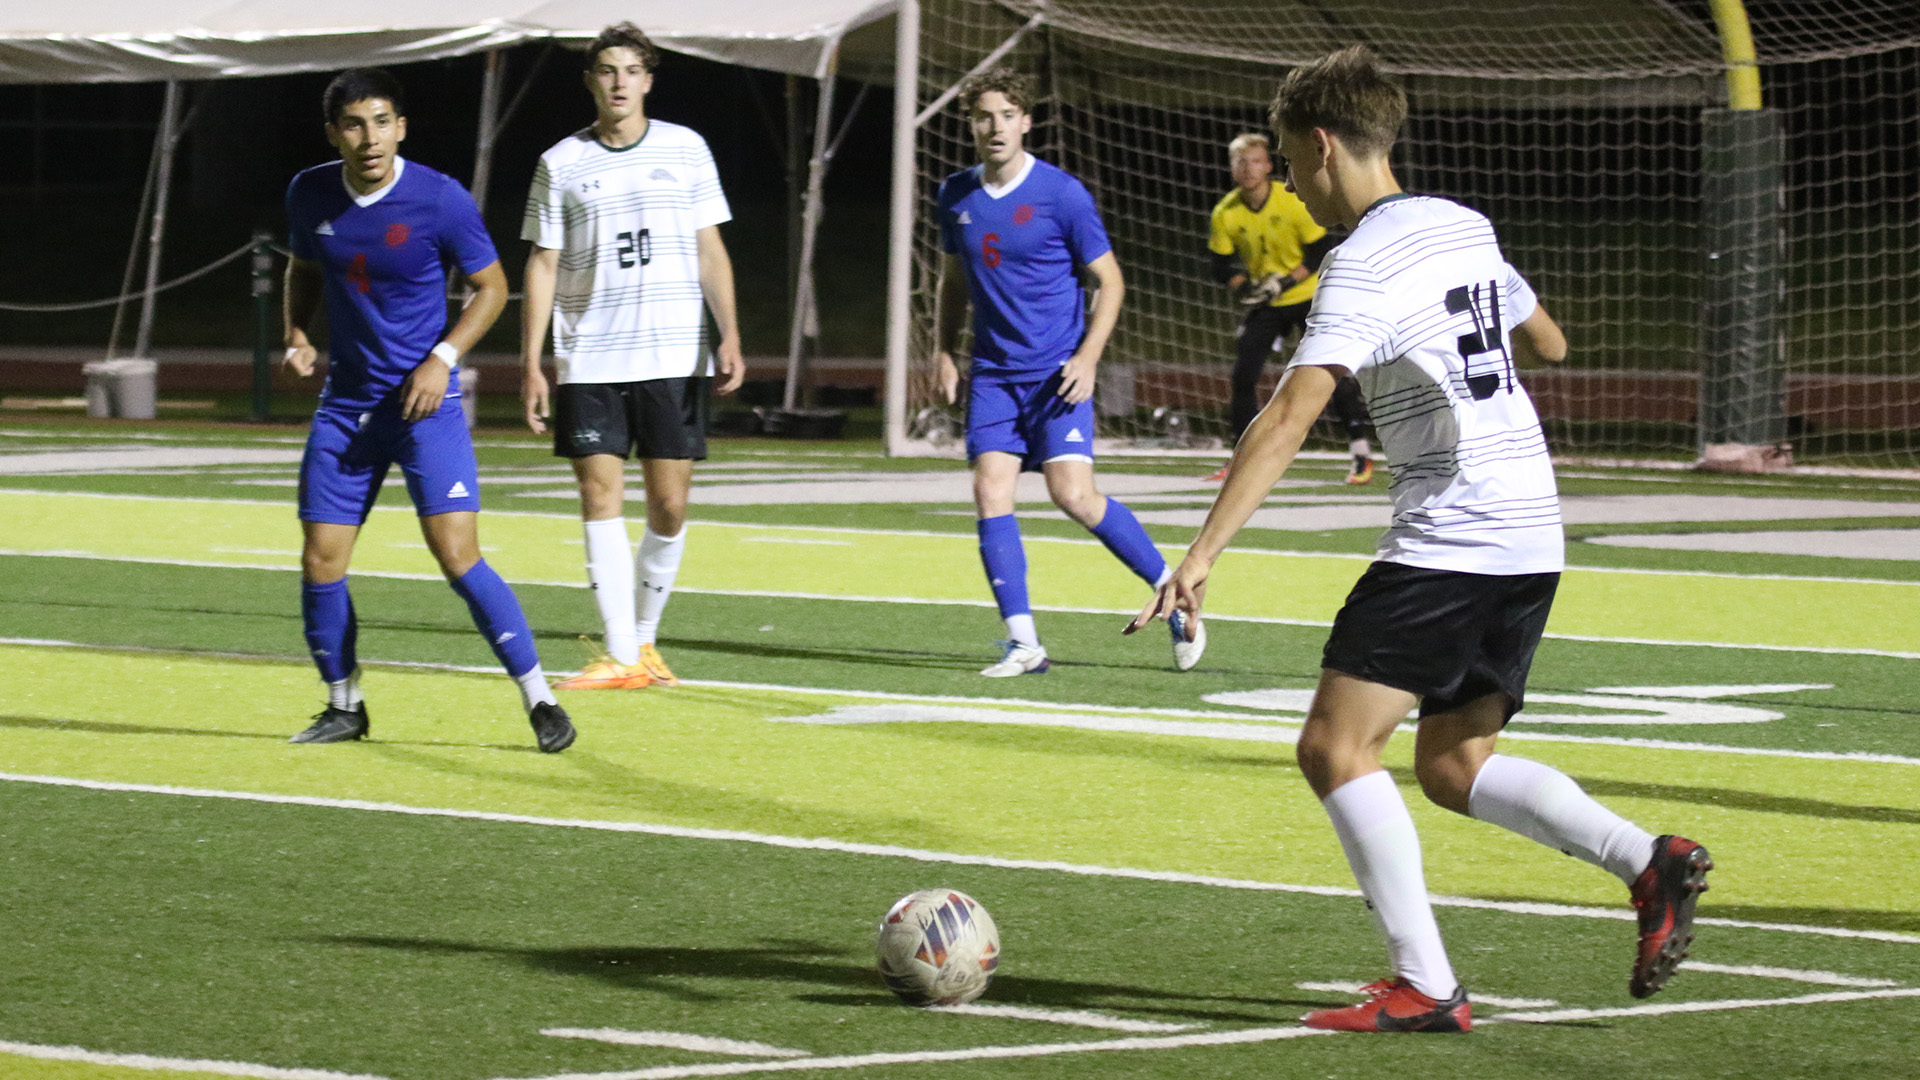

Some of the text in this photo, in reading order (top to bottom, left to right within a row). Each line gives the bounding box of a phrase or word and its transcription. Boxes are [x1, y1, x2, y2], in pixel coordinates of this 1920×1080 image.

[616, 228, 650, 269] 20
[982, 232, 1001, 268] 6
[347, 252, 370, 293] 4
